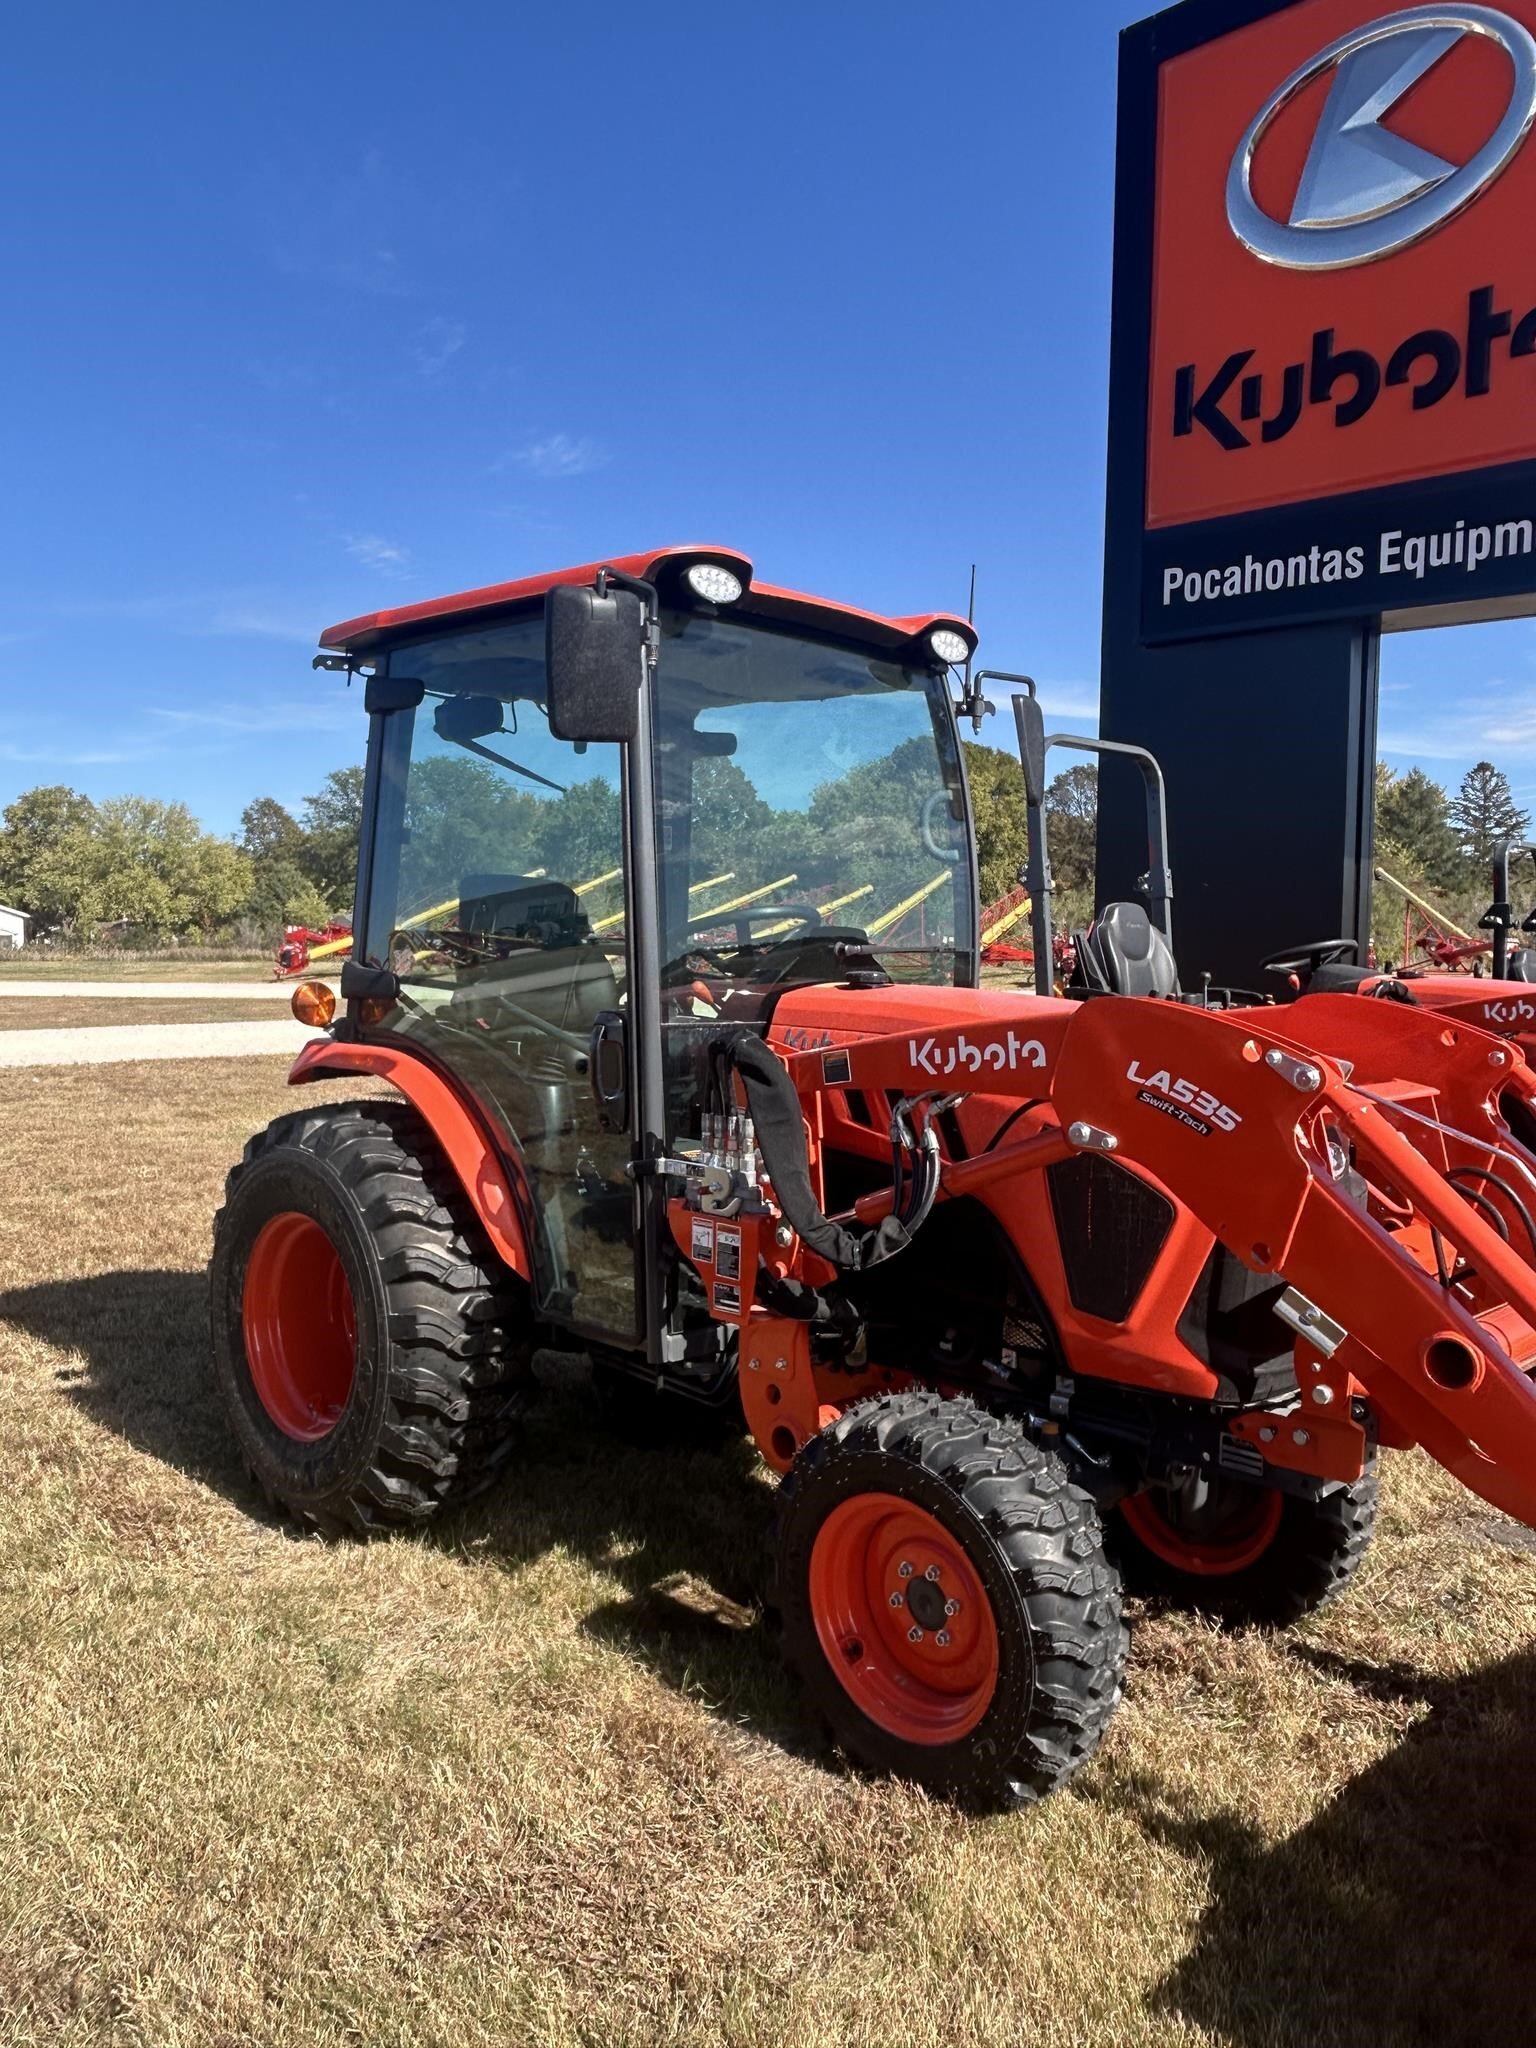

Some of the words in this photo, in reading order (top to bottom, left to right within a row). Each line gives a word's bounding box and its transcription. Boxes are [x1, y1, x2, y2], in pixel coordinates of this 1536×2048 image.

[1162, 544, 1364, 605] Pocahontas
[1379, 519, 1533, 580] Equipm
[909, 1031, 1046, 1075] Kubota
[1126, 1060, 1243, 1132] LA535
[1139, 1092, 1208, 1135] Swift-Tach
